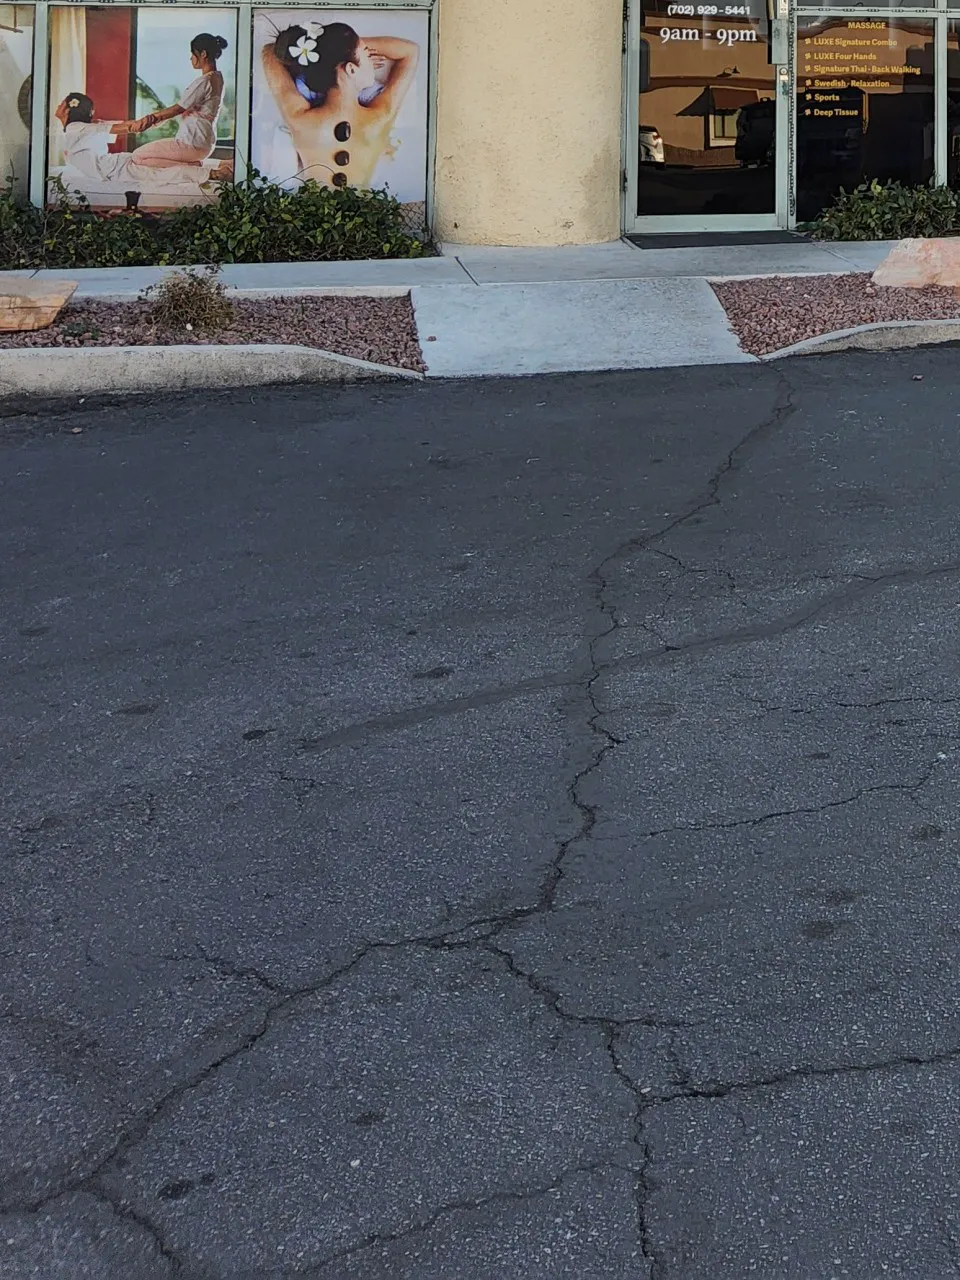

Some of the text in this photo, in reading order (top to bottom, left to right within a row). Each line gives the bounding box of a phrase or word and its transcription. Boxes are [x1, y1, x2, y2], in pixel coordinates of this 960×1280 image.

[668, 5, 694, 16] (702)
[660, 27, 700, 44] 9am
[716, 28, 758, 46] 9pm
[834, 38, 870, 48] Signature
[814, 64, 850, 74] Signature
[891, 66, 921, 75] Walking
[850, 80, 890, 88] Relaxation
[814, 94, 840, 102] Sports
[814, 108, 859, 117] Deep Tissue
